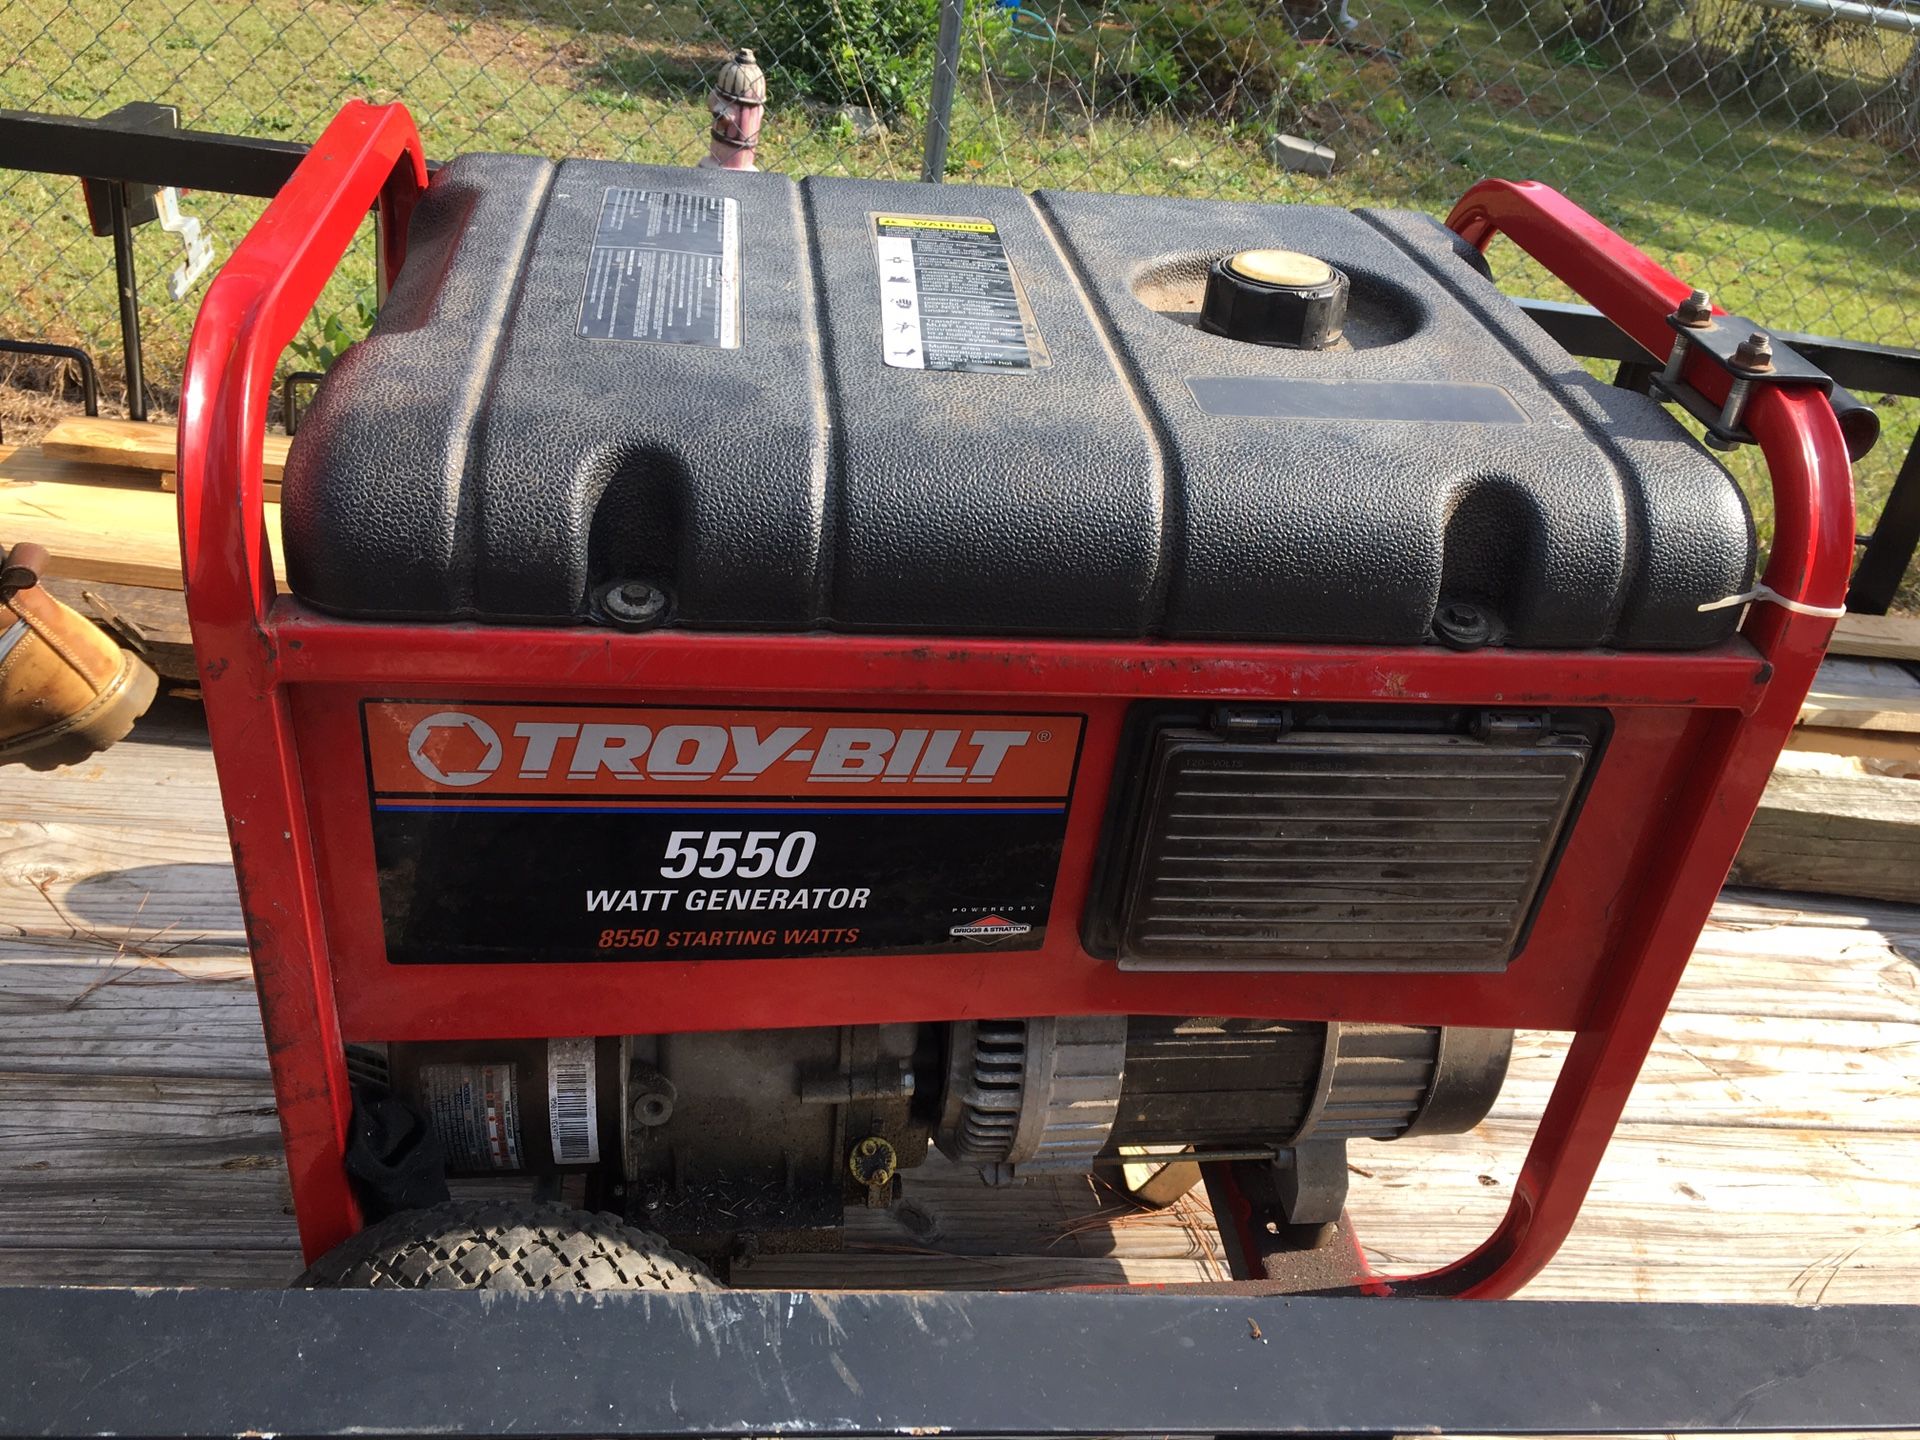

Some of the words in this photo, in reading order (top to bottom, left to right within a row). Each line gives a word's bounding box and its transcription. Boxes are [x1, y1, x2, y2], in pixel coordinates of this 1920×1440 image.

[913, 221, 991, 231] WARNING
[512, 722, 1032, 784] TROY-BILT
[660, 831, 817, 878] 5550
[586, 890, 679, 911] WATT
[685, 888, 871, 911] GENERATOR
[599, 929, 660, 947] 8550
[666, 930, 776, 947] STARTING
[784, 928, 860, 944] WATTS
